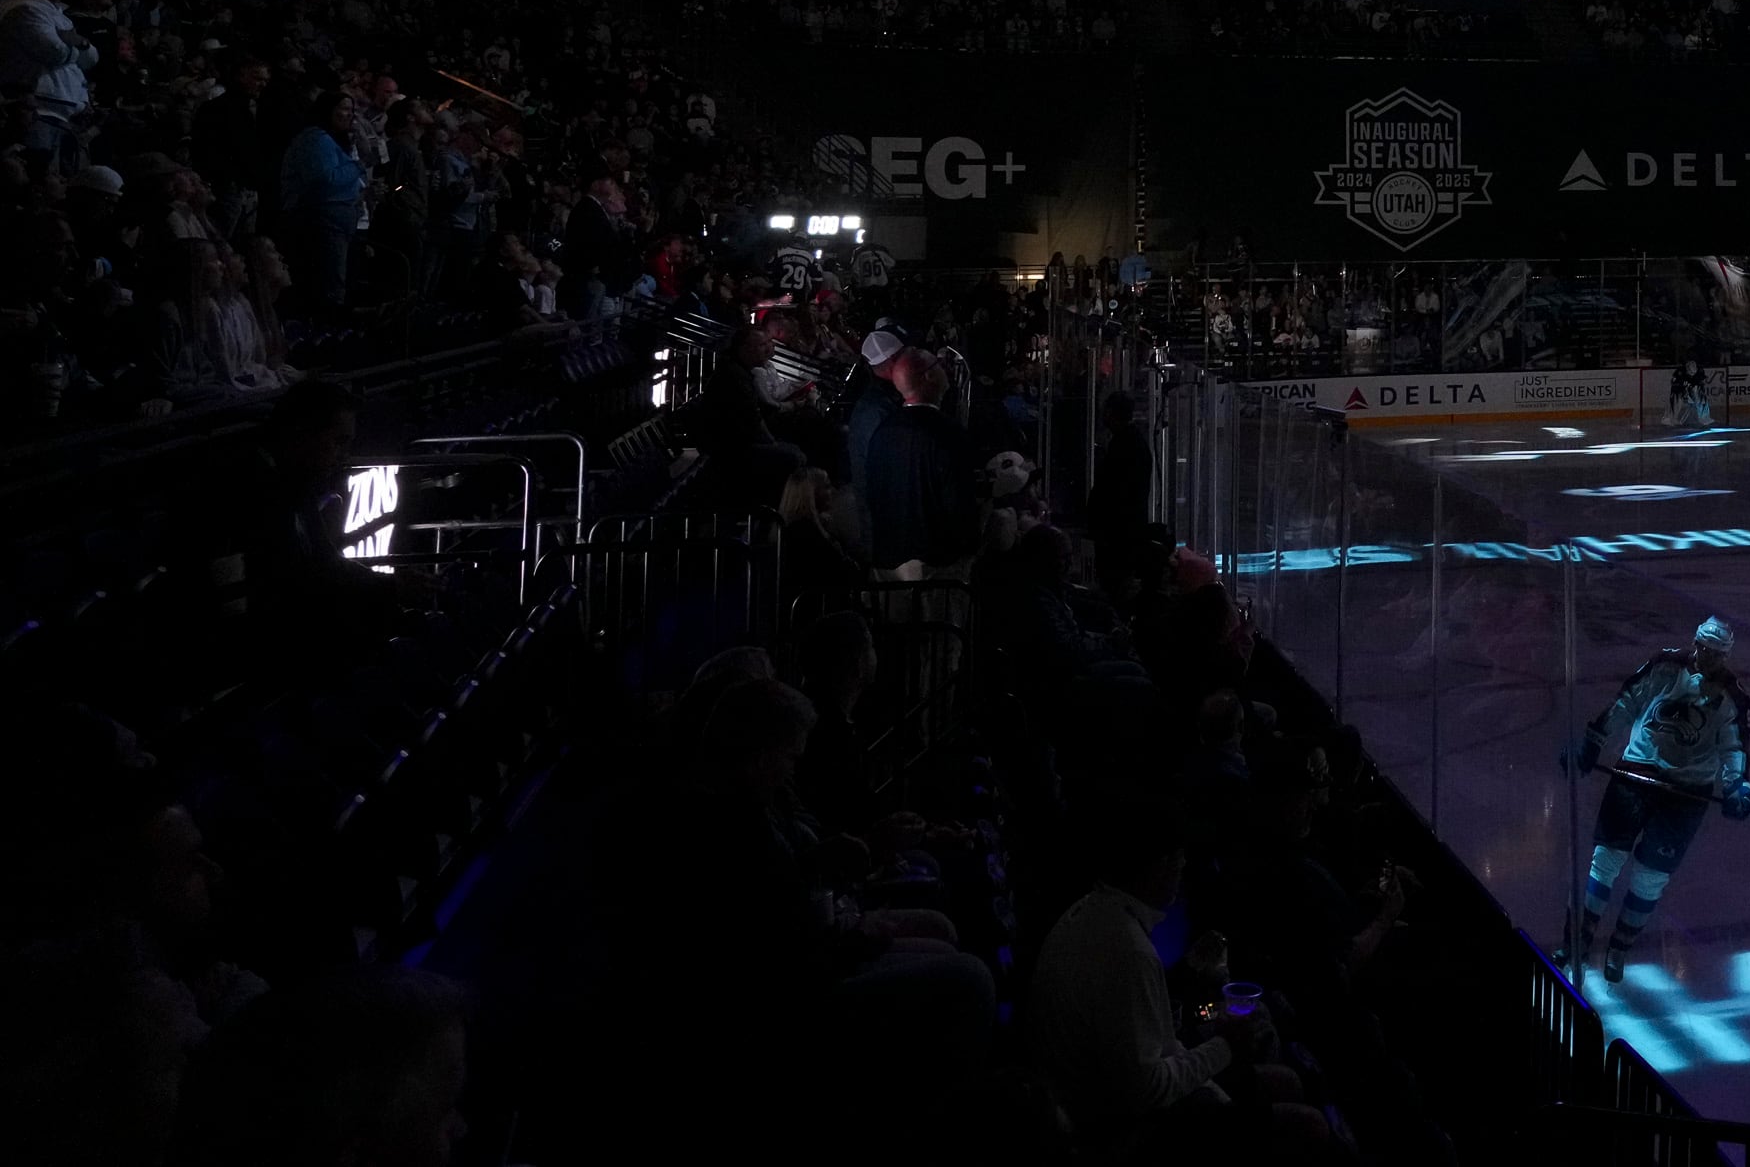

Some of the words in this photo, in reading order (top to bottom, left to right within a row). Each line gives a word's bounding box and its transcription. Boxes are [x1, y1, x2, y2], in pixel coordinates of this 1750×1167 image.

[1353, 121, 1455, 141] INAUGURAL
[1353, 142, 1455, 169] SEASON
[1336, 173, 1373, 188] 2024
[1435, 173, 1472, 188] 2025
[1383, 193, 1426, 214] UTAH
[780, 264, 807, 290] 29
[1519, 375, 1550, 387] JUST
[1379, 385, 1486, 406] DELTA
[1520, 385, 1613, 399] INGREDIENTS
